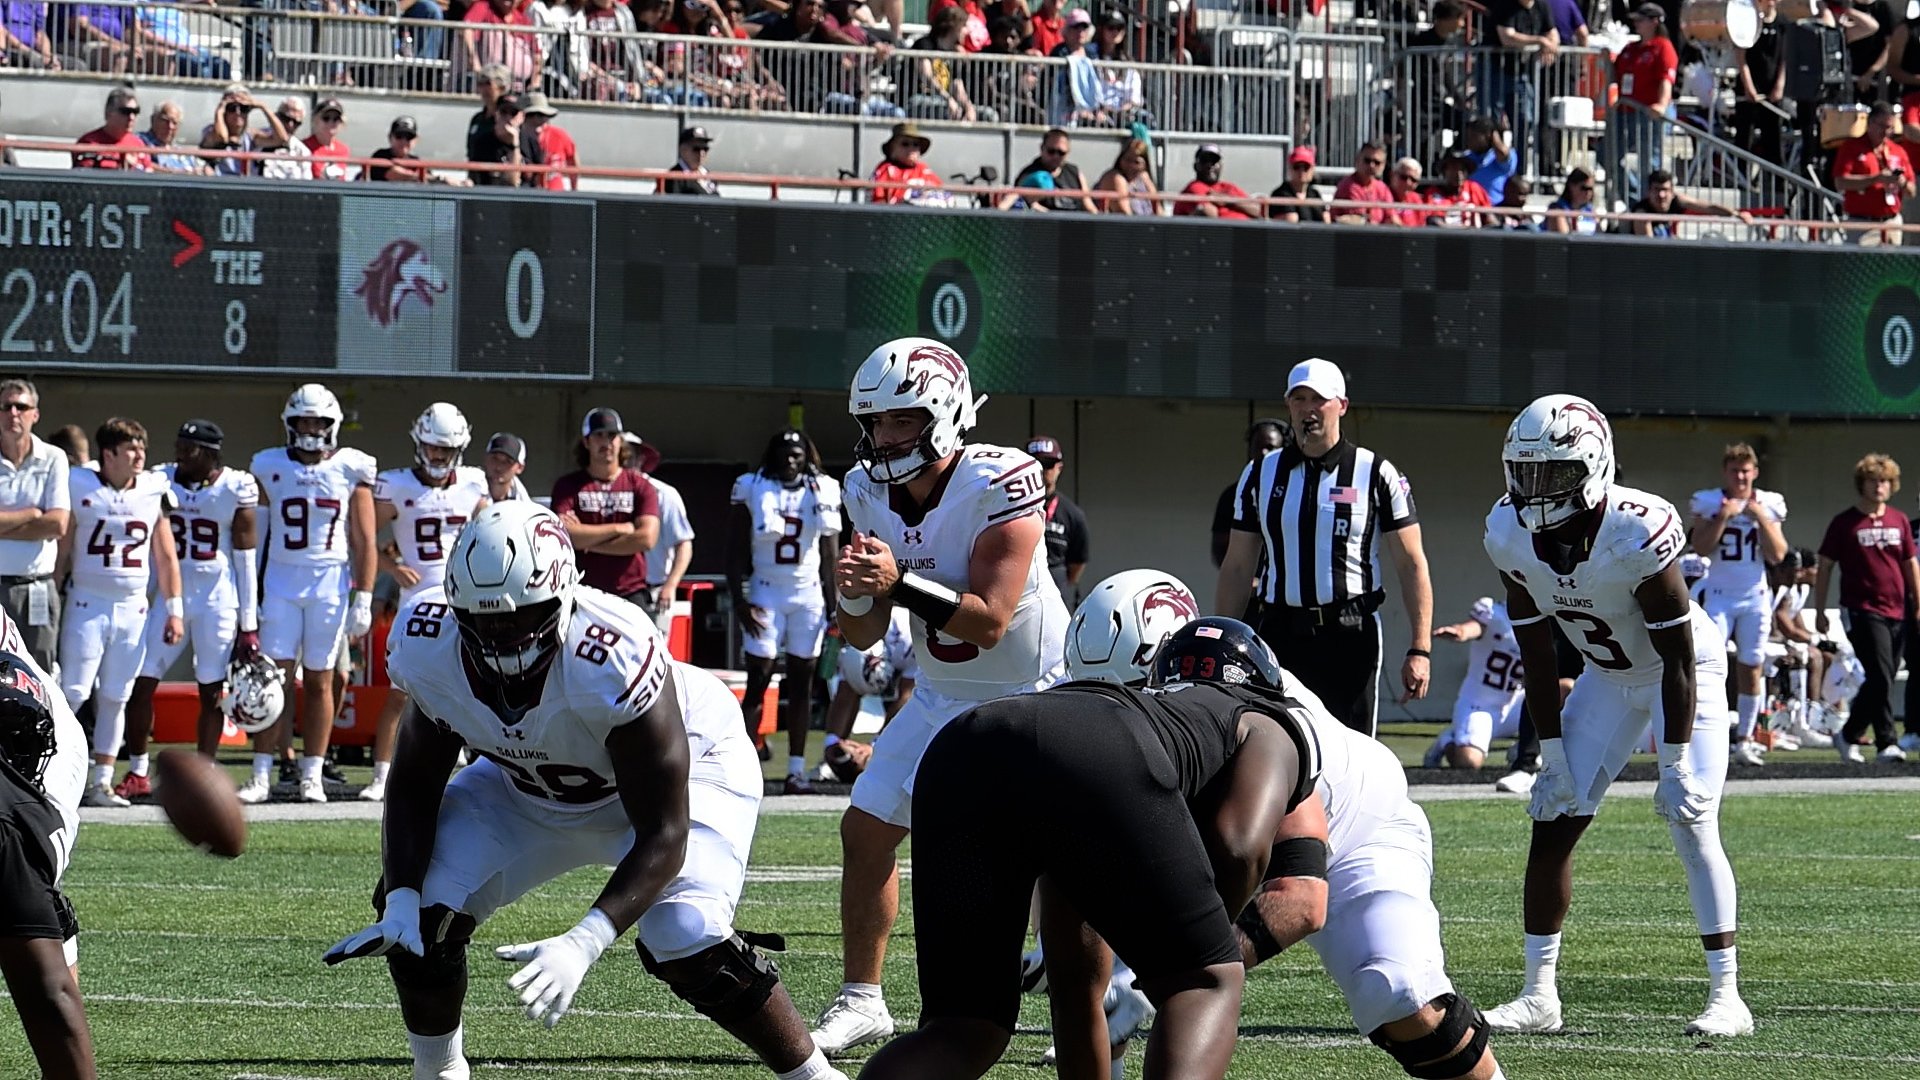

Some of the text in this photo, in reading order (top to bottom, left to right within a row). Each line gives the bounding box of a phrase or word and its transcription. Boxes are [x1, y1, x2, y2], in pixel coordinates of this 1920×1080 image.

[221, 209, 255, 242] ON
[210, 250, 263, 284] THE
[506, 248, 545, 338] 0
[0, 268, 138, 354] 2:04
[224, 299, 248, 355] 8
[857, 400, 873, 410] SIU
[1518, 450, 1535, 458] SIU
[1004, 469, 1046, 503] SIU
[281, 498, 341, 550] 97
[1618, 500, 1649, 518] 3
[87, 519, 149, 568] 42
[775, 516, 803, 564] 8
[1334, 518, 1349, 537] R
[1719, 526, 1758, 562] 91
[898, 558, 936, 570] SALUKIS
[478, 599, 501, 610] SIU
[1552, 594, 1594, 609] SALUKIS
[575, 622, 622, 666] 68
[1555, 609, 1633, 671] 3
[1181, 655, 1217, 679] 93
[496, 746, 549, 761] SALUKIS
